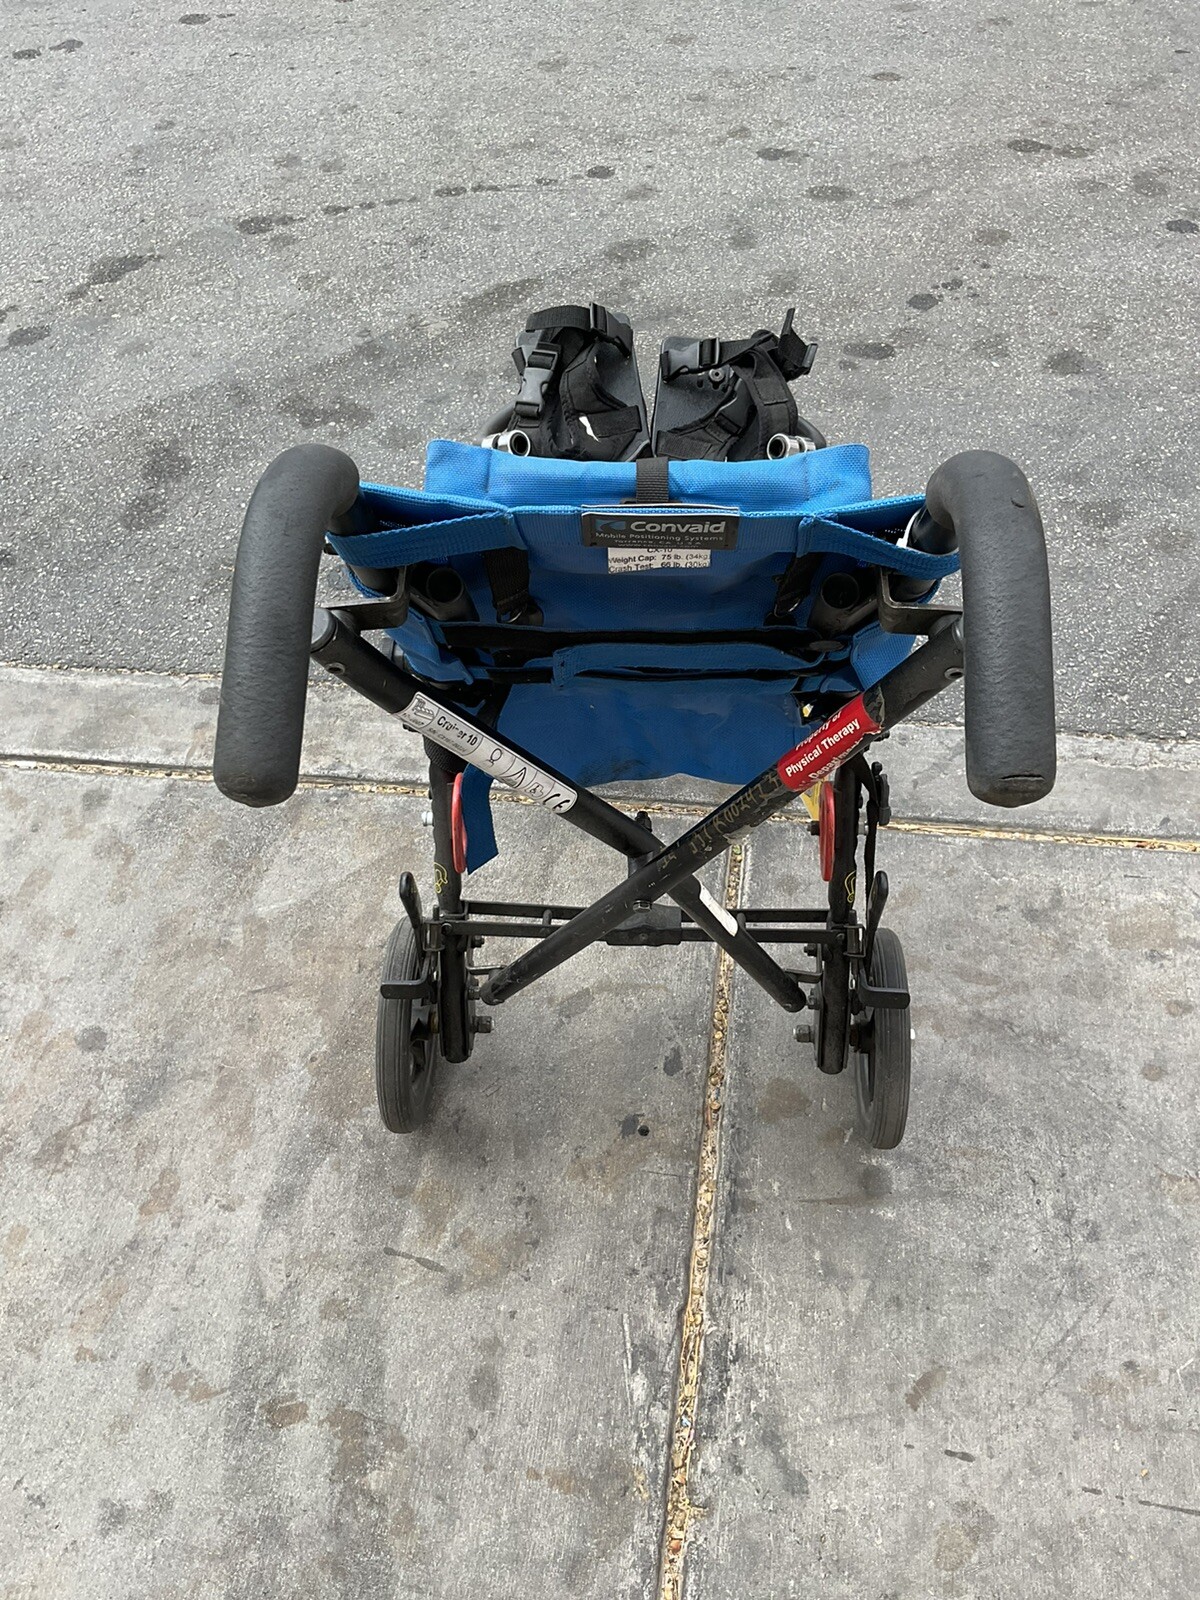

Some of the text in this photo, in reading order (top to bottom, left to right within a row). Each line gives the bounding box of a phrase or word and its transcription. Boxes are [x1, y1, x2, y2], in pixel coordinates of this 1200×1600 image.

[629, 533, 681, 541] Positioning
[630, 521, 726, 533] Convaid
[437, 715, 467, 740] Cruier
[466, 734, 478, 746] 10
[785, 718, 860, 777] Physical Therapy
